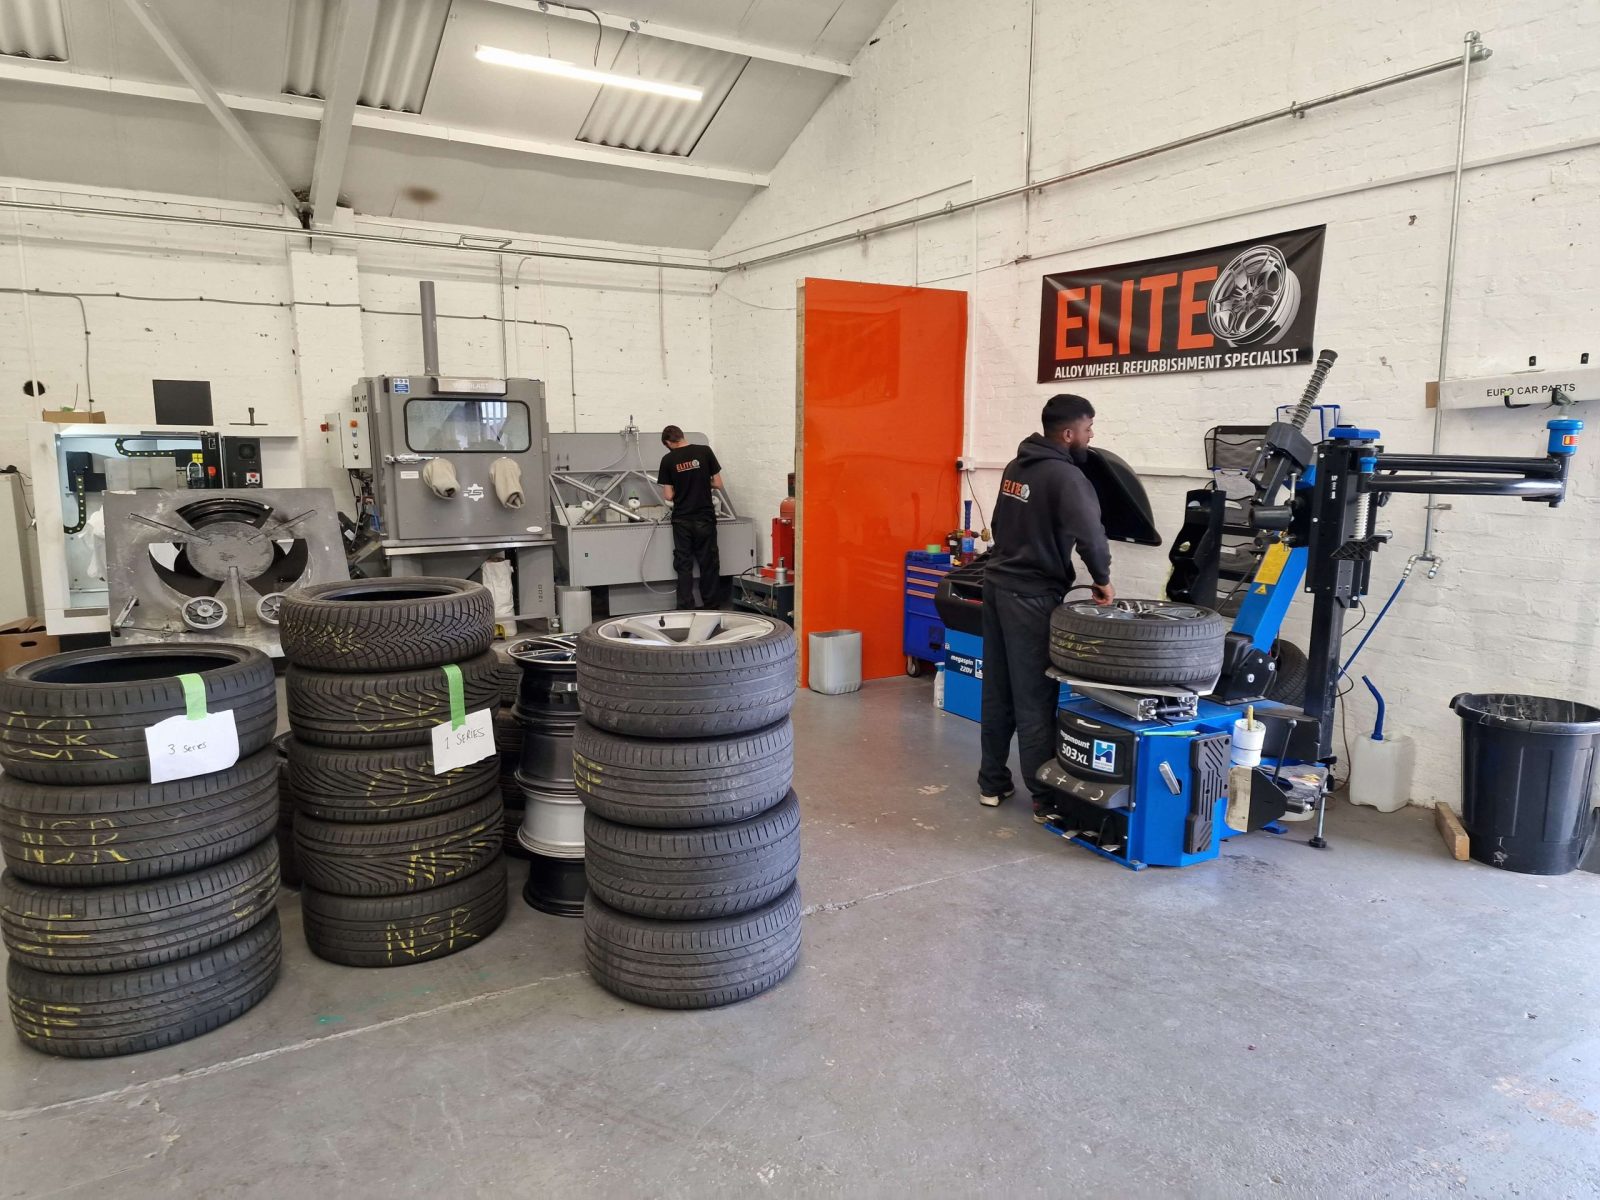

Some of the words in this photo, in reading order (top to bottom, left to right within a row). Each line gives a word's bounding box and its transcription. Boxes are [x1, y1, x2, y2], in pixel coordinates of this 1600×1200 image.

[1055, 265, 1219, 360] ELITE
[1054, 364, 1084, 379] ALLOY
[1085, 361, 1121, 377] WHEEL
[1122, 354, 1221, 375] REFURBISHMENT
[1223, 347, 1299, 369] SPECIALIST
[1517, 385, 1539, 395] CAR
[950, 655, 974, 666] megaspin
[456, 728, 485, 745] SERIES
[168, 743, 176, 755] 3
[1061, 743, 1089, 766] 503XL
[386, 907, 481, 964] NSR
